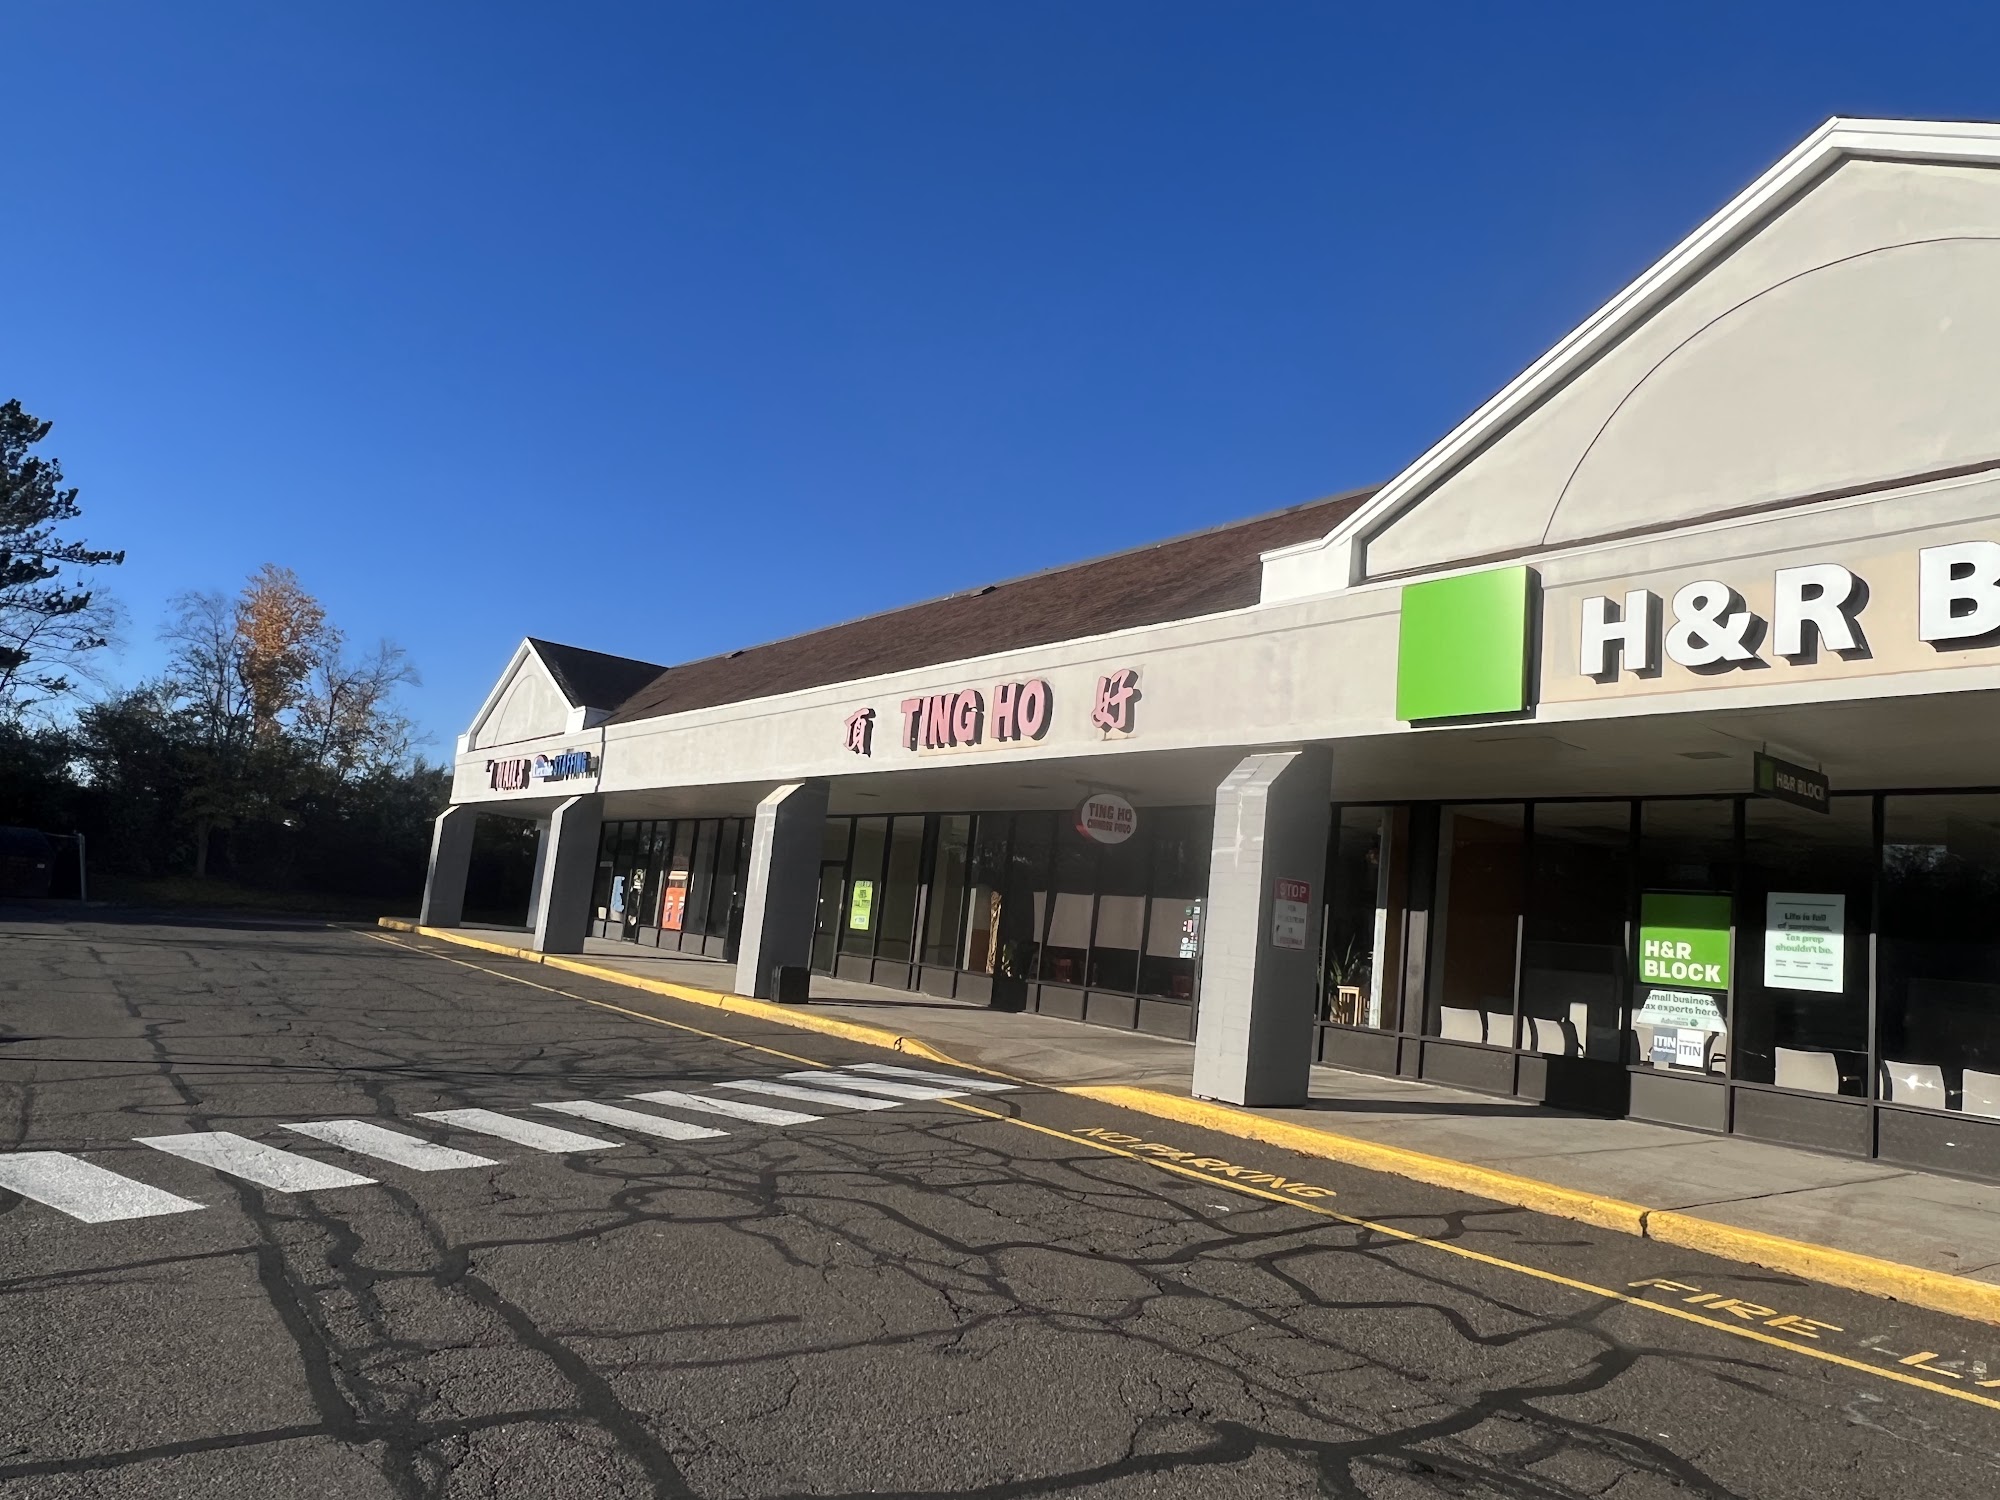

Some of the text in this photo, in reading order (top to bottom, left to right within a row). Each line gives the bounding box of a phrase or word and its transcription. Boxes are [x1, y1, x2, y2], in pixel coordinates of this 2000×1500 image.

[1580, 562, 1864, 677] H&R
[1091, 668, 1140, 733] 好
[900, 678, 1050, 750] TING HO
[552, 752, 589, 777] STAFFING
[1776, 771, 1797, 792] H&R
[1089, 802, 1132, 822] TING HO
[1280, 882, 1307, 898] STOP
[1644, 939, 1692, 960] H&R
[1775, 943, 1817, 954] shouldn't
[1644, 959, 1722, 983] BLOCK
[1657, 1003, 1694, 1014] experts
[1653, 1035, 1677, 1049] ITIN
[1678, 1044, 1702, 1057] ITIN
[1071, 1127, 1338, 1198] NO PARKING
[1627, 1278, 1844, 1339] FIRE
